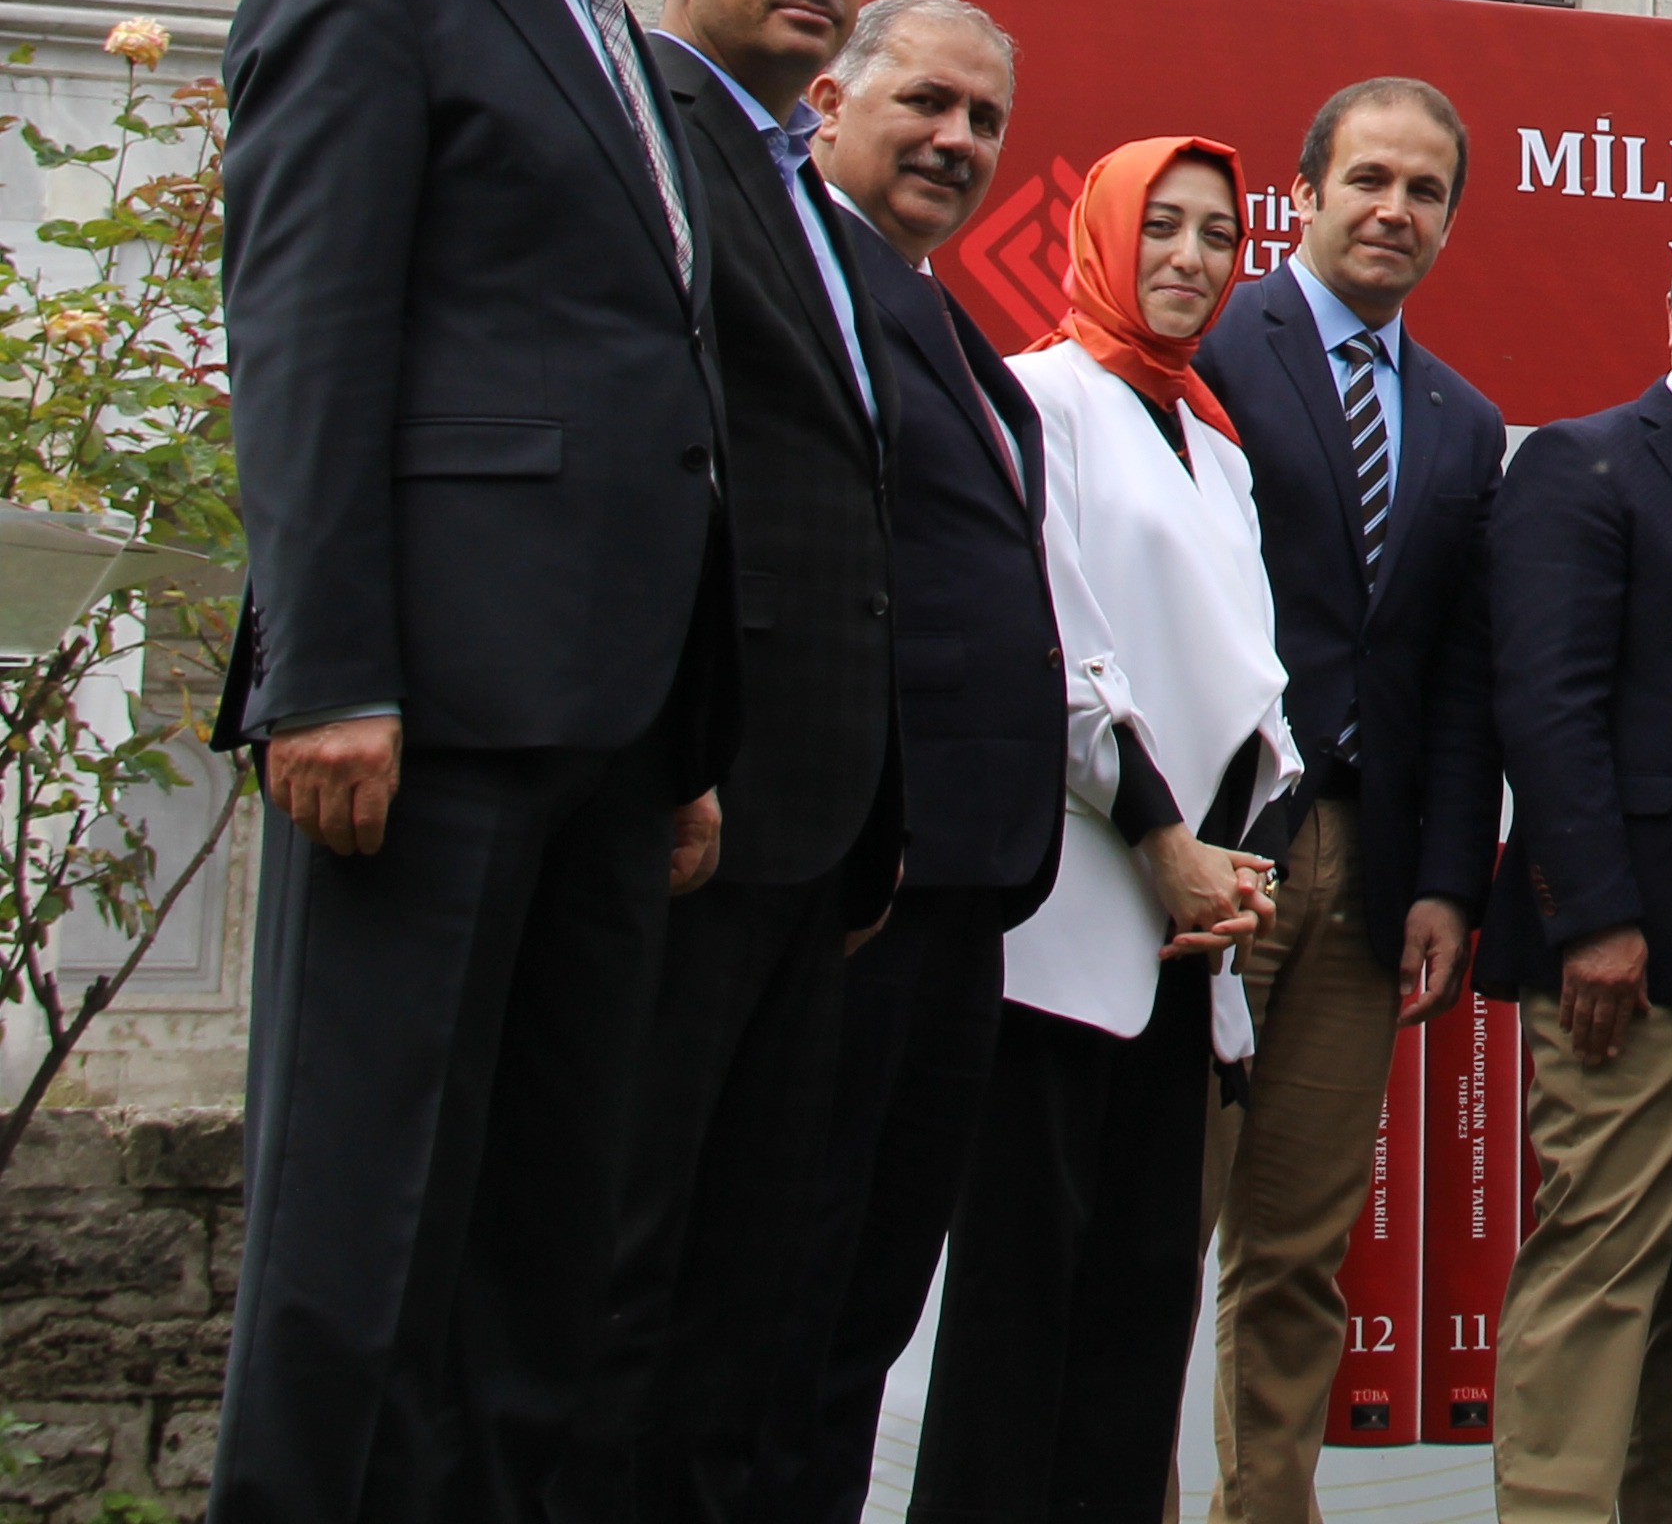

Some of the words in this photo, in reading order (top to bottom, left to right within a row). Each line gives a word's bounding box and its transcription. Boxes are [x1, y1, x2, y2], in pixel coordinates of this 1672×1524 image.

[1246, 185, 1300, 232] TİH
[1472, 1017, 1488, 1130] MÜCADELE'NİN
[1457, 1075, 1469, 1140] 1918-1923
[1374, 1135, 1388, 1184] YEREL
[1471, 1135, 1485, 1184] YEREL
[1374, 1186, 1389, 1240] TARİHİ
[1471, 1187, 1487, 1239] TARİHİ
[1350, 1315, 1396, 1352] 12
[1450, 1313, 1491, 1350] 11
[1353, 1388, 1389, 1402] TÜBA
[1453, 1386, 1488, 1399] TÜBA
